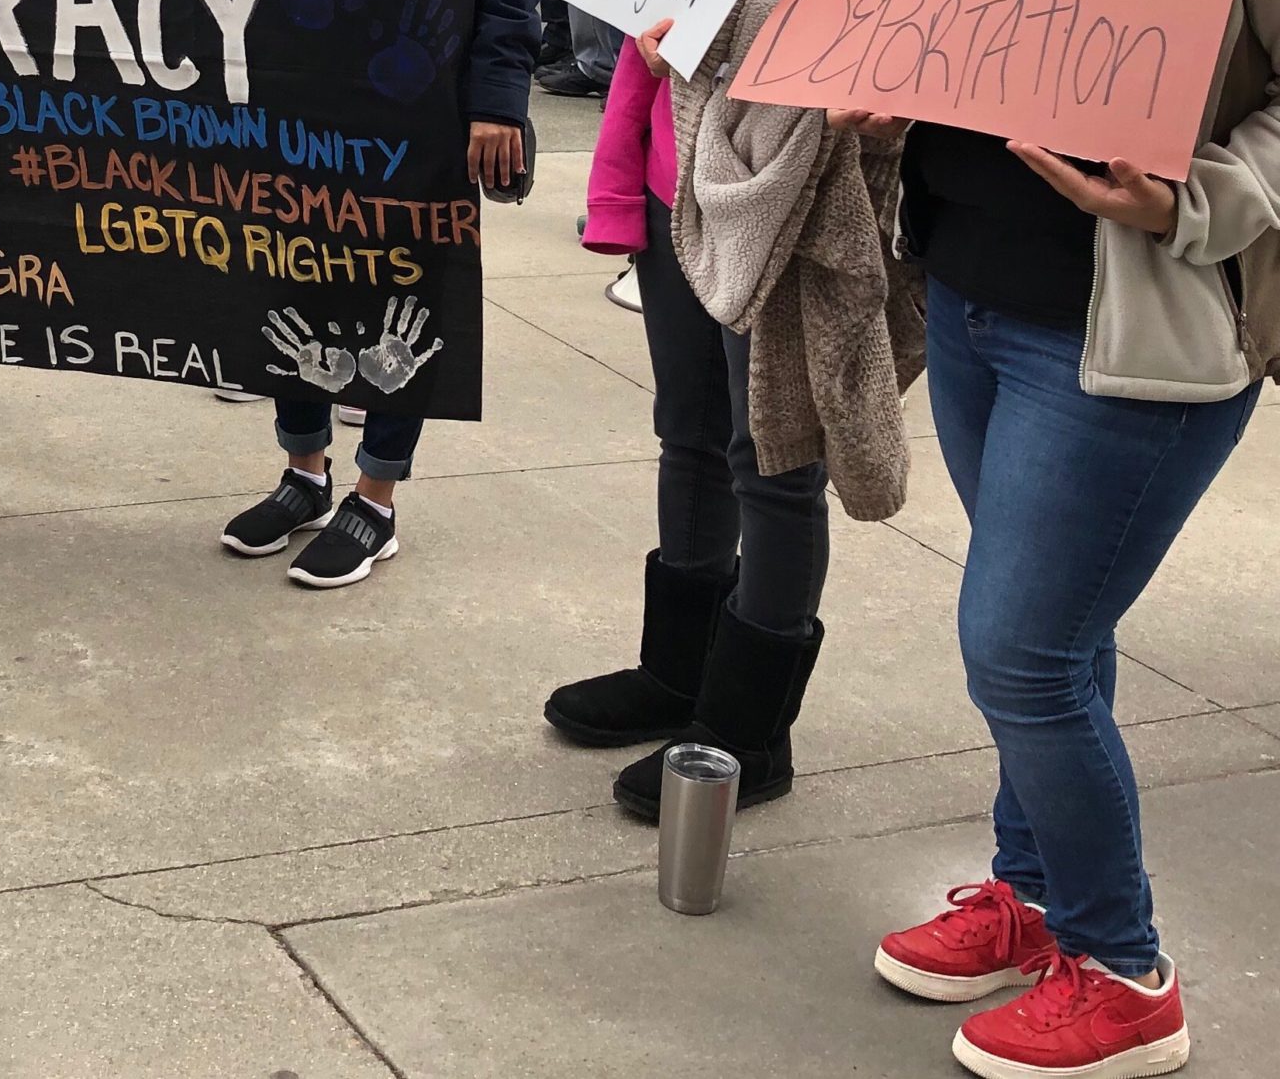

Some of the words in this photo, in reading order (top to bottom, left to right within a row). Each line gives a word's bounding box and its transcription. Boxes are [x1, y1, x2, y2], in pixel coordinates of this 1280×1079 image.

[134, 97, 268, 150] BROWN
[279, 119, 410, 182] UNITY
[8, 144, 481, 248] #BLACKLIVESMATTER
[75, 202, 232, 274] LGBTQ
[243, 223, 424, 287] RIGHTS
[45, 323, 95, 366] IS
[114, 331, 243, 391] REAL
